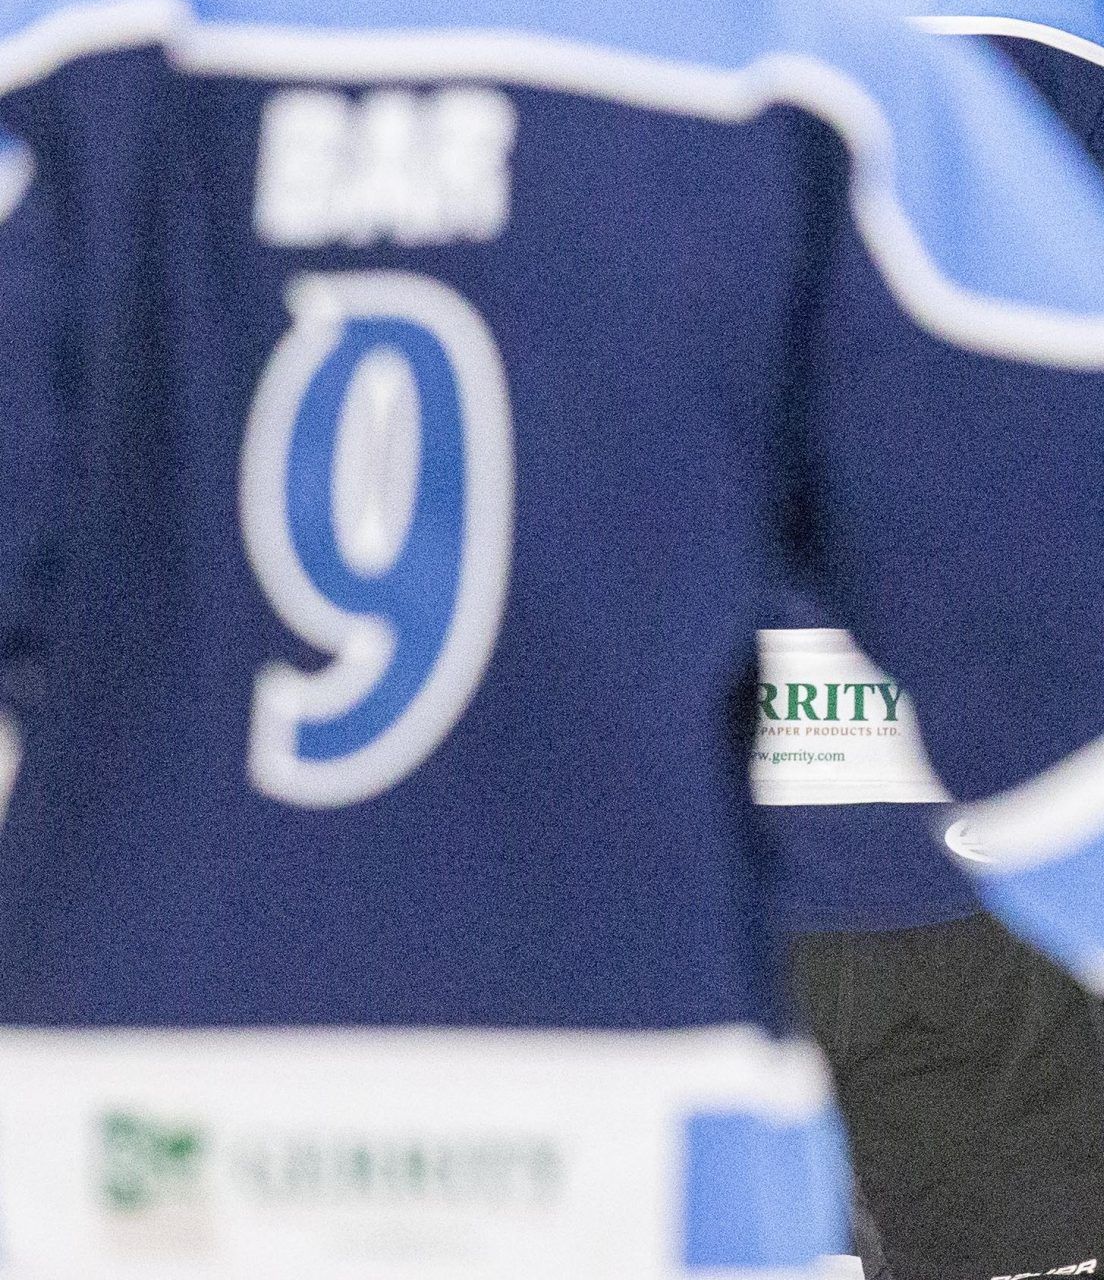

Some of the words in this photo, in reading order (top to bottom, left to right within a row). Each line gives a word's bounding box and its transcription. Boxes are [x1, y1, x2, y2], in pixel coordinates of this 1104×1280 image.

[240, 268, 516, 808] 9
[757, 682, 901, 721] RRITY
[761, 726, 800, 736] PAPER
[806, 726, 872, 736] PRODUCTS
[877, 726, 901, 736] LTD.
[754, 749, 845, 764] w.gerrity.com
